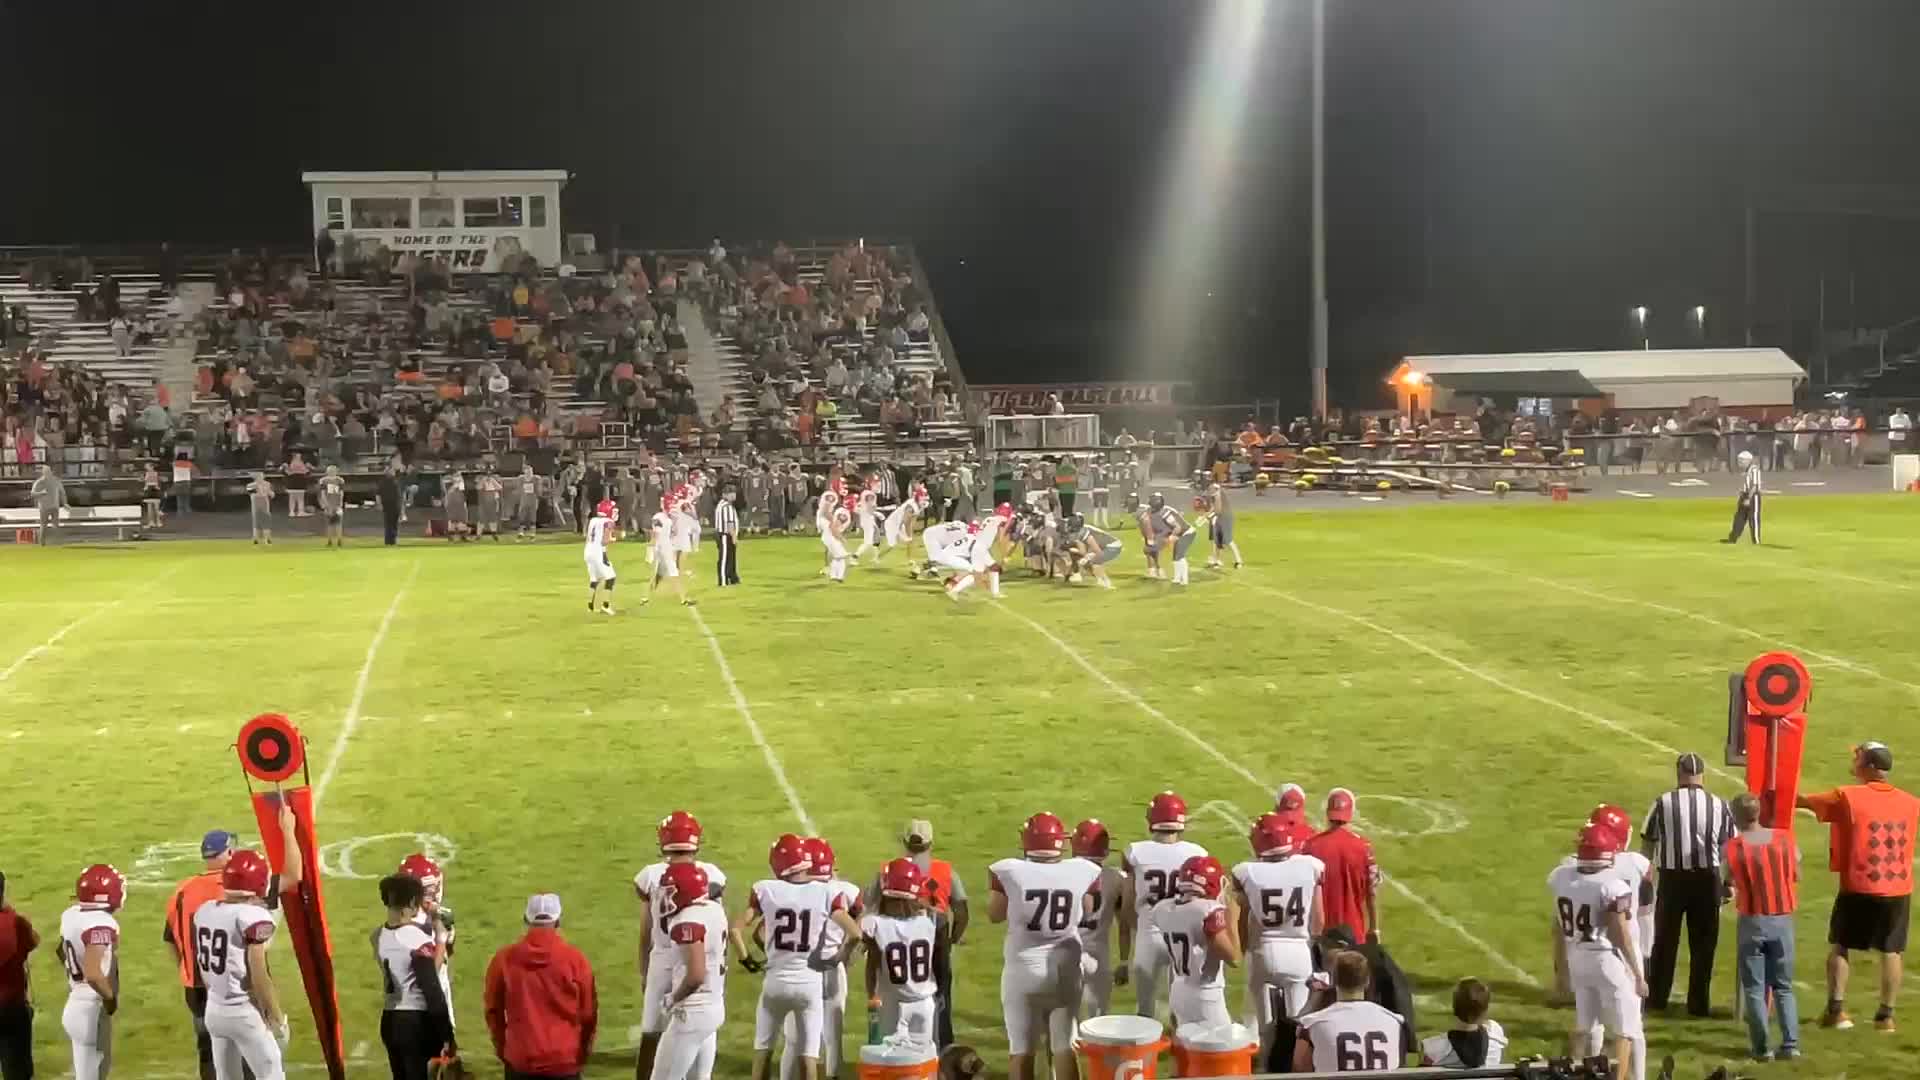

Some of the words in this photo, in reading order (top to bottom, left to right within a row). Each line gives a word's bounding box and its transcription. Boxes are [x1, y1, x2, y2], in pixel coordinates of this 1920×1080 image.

[394, 235, 433, 245] HOME
[436, 235, 453, 245] OF
[460, 235, 489, 245] THE
[1025, 889, 1073, 932] 78
[1261, 887, 1306, 928] 54
[1558, 896, 1595, 943] 84
[198, 927, 228, 975] 69
[774, 908, 812, 953] 21
[886, 939, 932, 985] 88
[1336, 1031, 1388, 1072] 66
